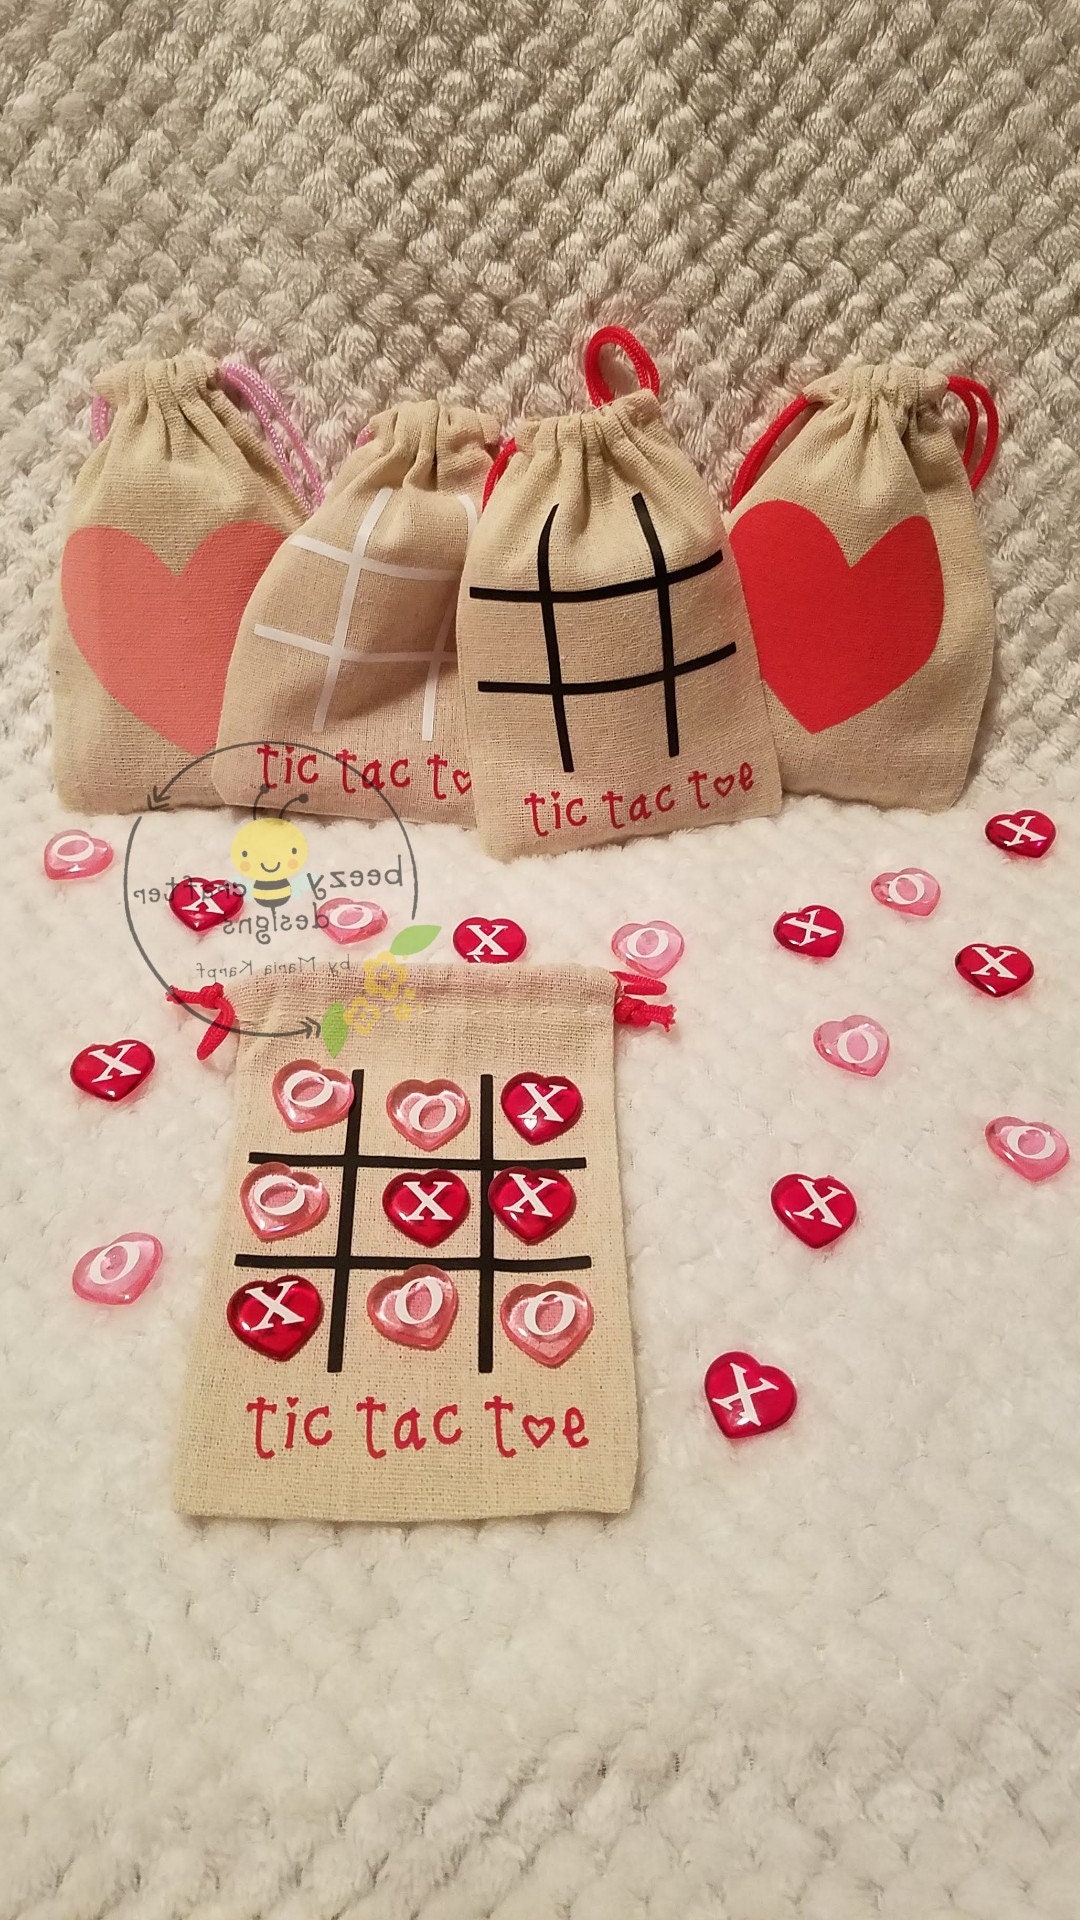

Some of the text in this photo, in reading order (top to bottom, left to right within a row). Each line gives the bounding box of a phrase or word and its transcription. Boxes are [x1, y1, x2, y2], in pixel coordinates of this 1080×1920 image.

[257, 744, 473, 800] tic tac to
[524, 790, 587, 837] tic
[602, 784, 675, 829] tac
[997, 815, 1047, 846] X
[51, 835, 95, 863] O
[888, 874, 925, 905] O
[329, 904, 373, 930] O
[784, 909, 836, 946] X
[466, 924, 509, 957] X
[627, 926, 669, 958] O
[970, 945, 1019, 979] X
[88, 1042, 142, 1084] X
[837, 1027, 878, 1064] O
[283, 1069, 334, 1108] O
[517, 1082, 568, 1123] X
[409, 1097, 457, 1133] O
[1006, 1125, 1056, 1160] O
[253, 1174, 306, 1216] O
[402, 1180, 453, 1221] X
[503, 1173, 558, 1218] X
[794, 1178, 847, 1229] X
[90, 1241, 141, 1285] O
[245, 1280, 305, 1332] X
[394, 1276, 444, 1325] O
[523, 1290, 576, 1337] O
[712, 1362, 780, 1427] X
[246, 1396, 333, 1459] tic
[356, 1396, 463, 1459] tac
